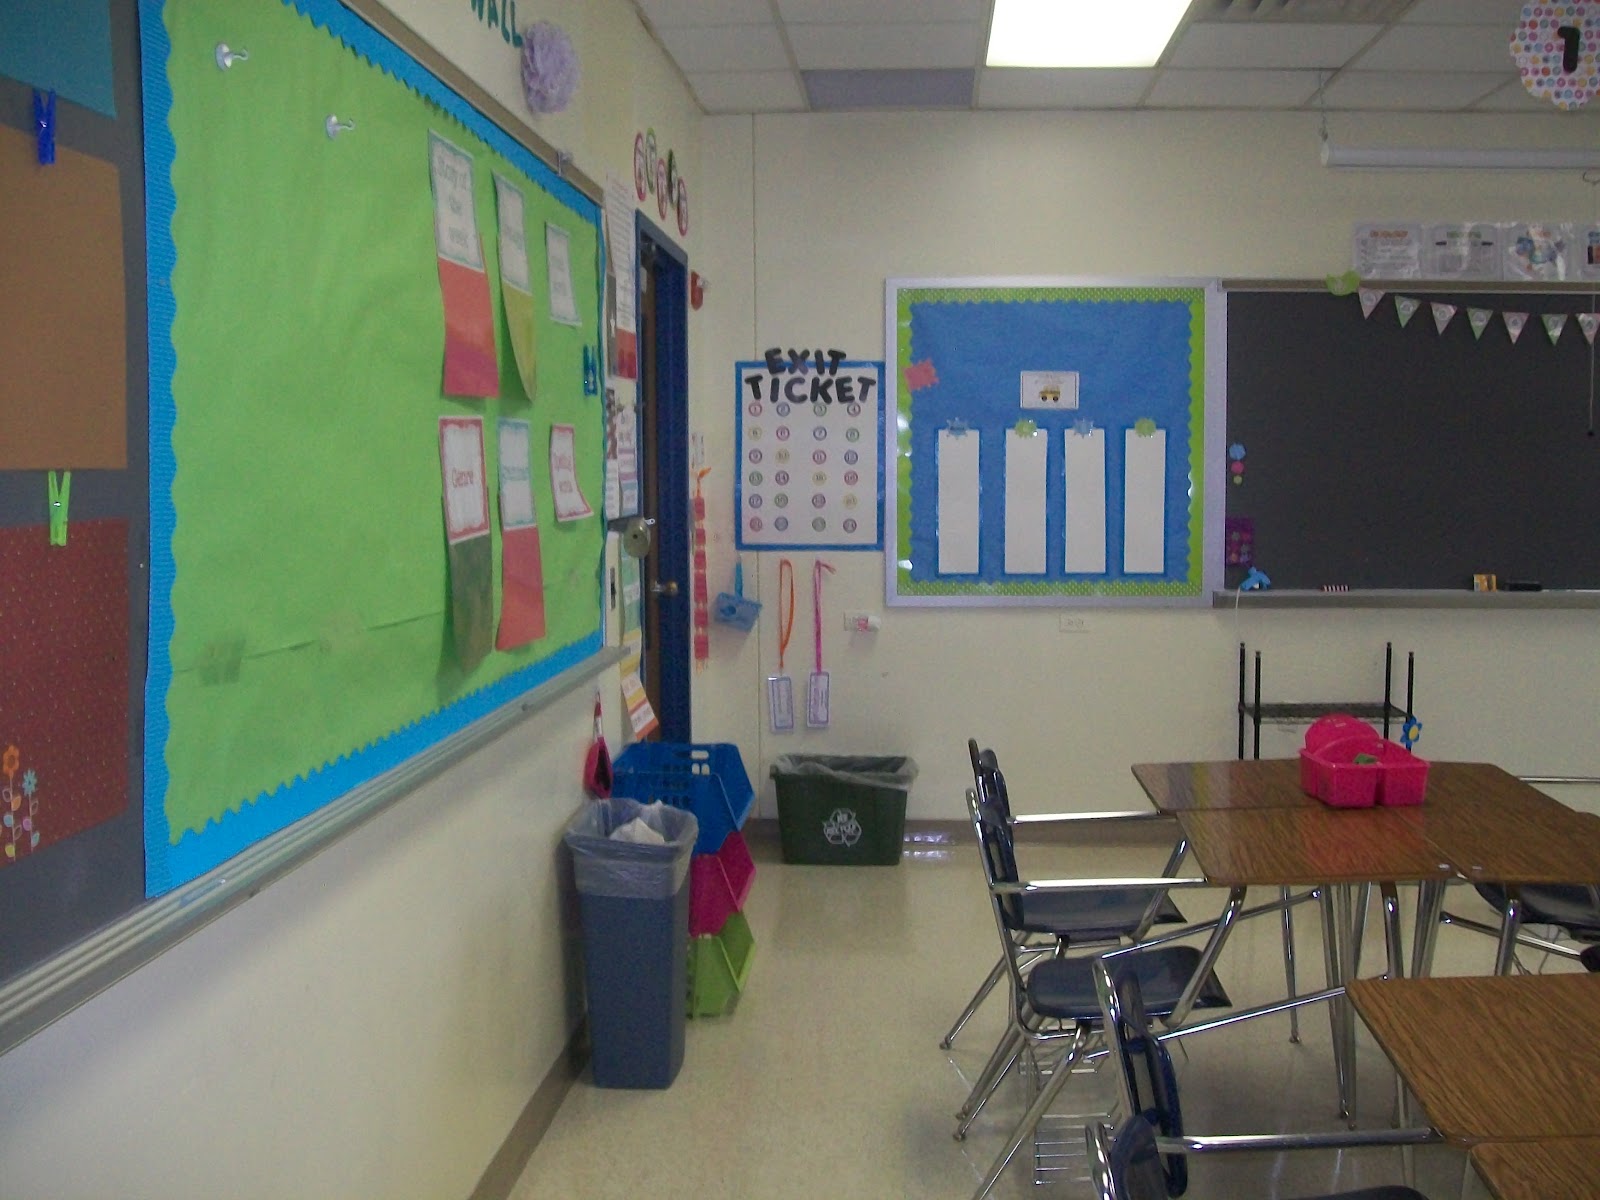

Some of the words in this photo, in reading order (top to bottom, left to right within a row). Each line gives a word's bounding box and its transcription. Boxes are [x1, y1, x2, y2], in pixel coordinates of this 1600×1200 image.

[1557, 26, 1581, 73] 1
[764, 347, 847, 376] EXIT
[744, 374, 876, 404] TICKET
